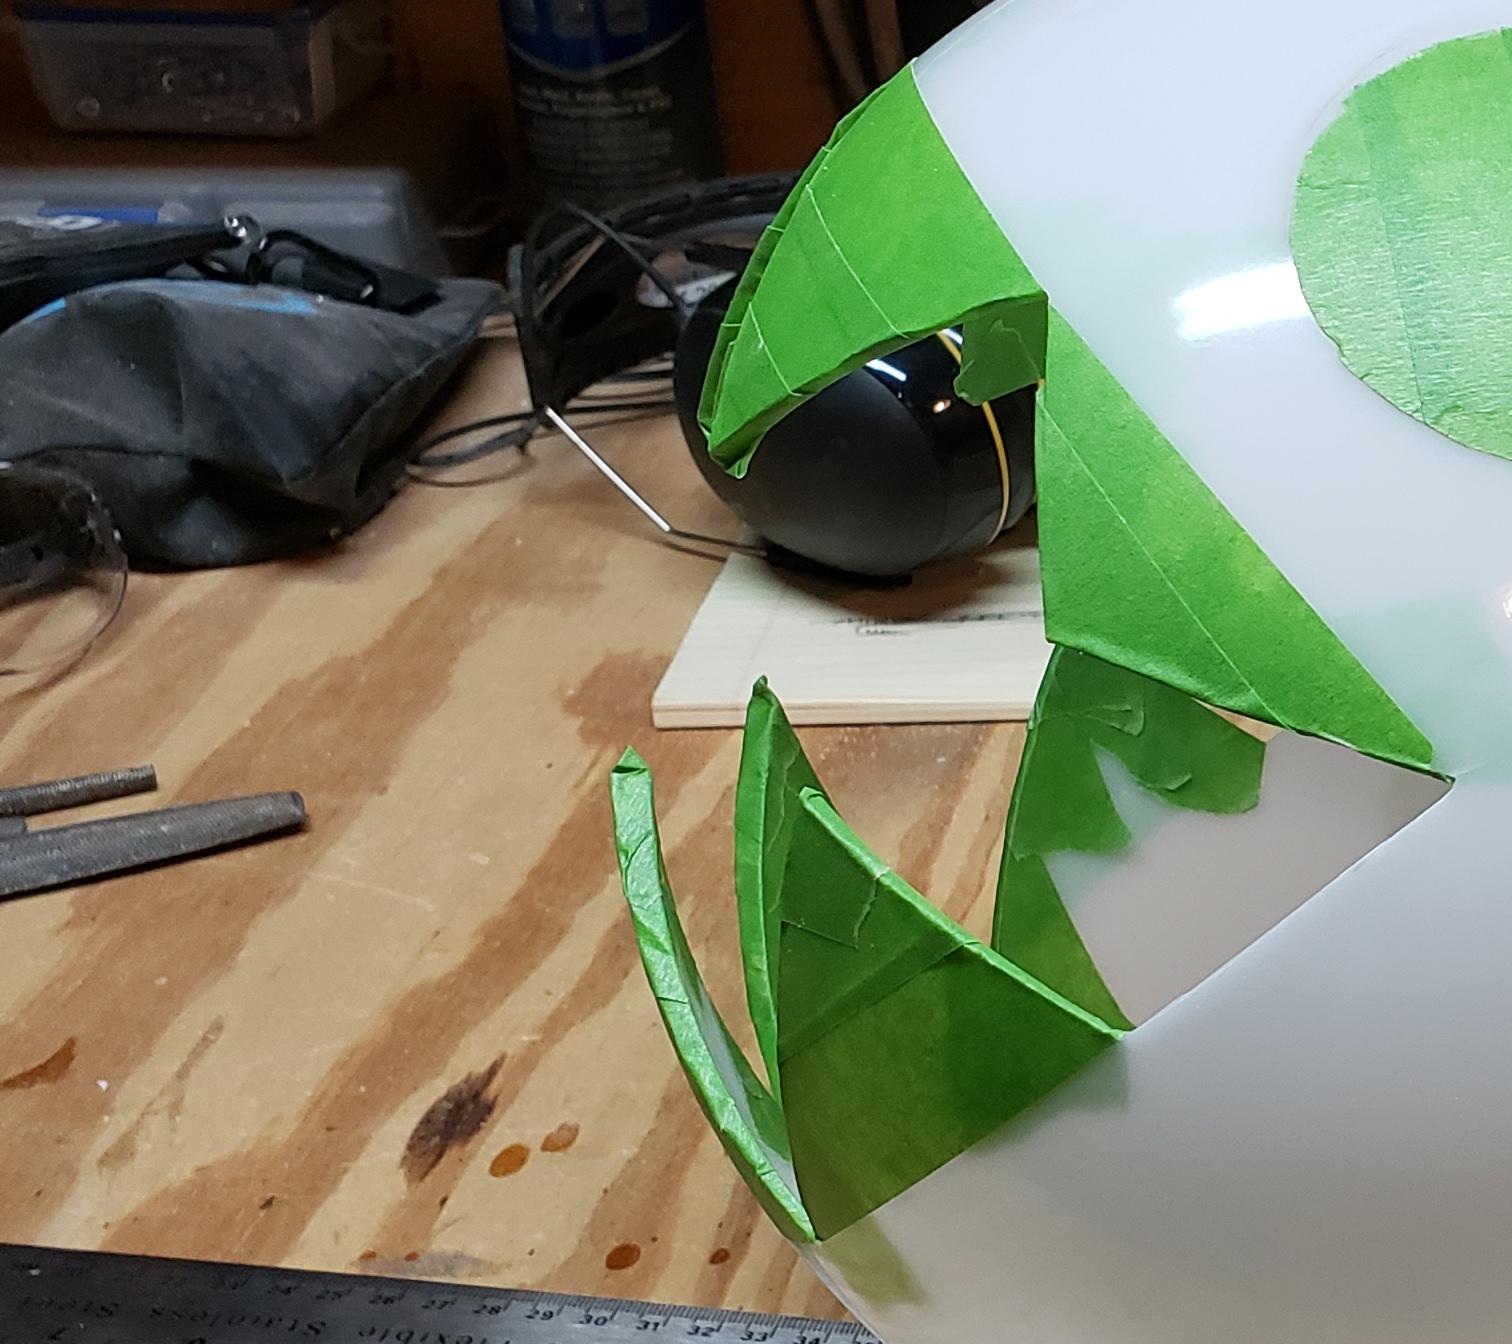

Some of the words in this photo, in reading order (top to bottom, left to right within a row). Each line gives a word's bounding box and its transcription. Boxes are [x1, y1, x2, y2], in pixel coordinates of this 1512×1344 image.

[151, 1306, 326, 1337] Stainless
[473, 1304, 502, 1316] 28
[527, 1309, 554, 1321] 29
[579, 1313, 608, 1326] 30
[635, 1319, 660, 1332] 31
[687, 1324, 716, 1337] 32
[740, 1329, 768, 1343] 33
